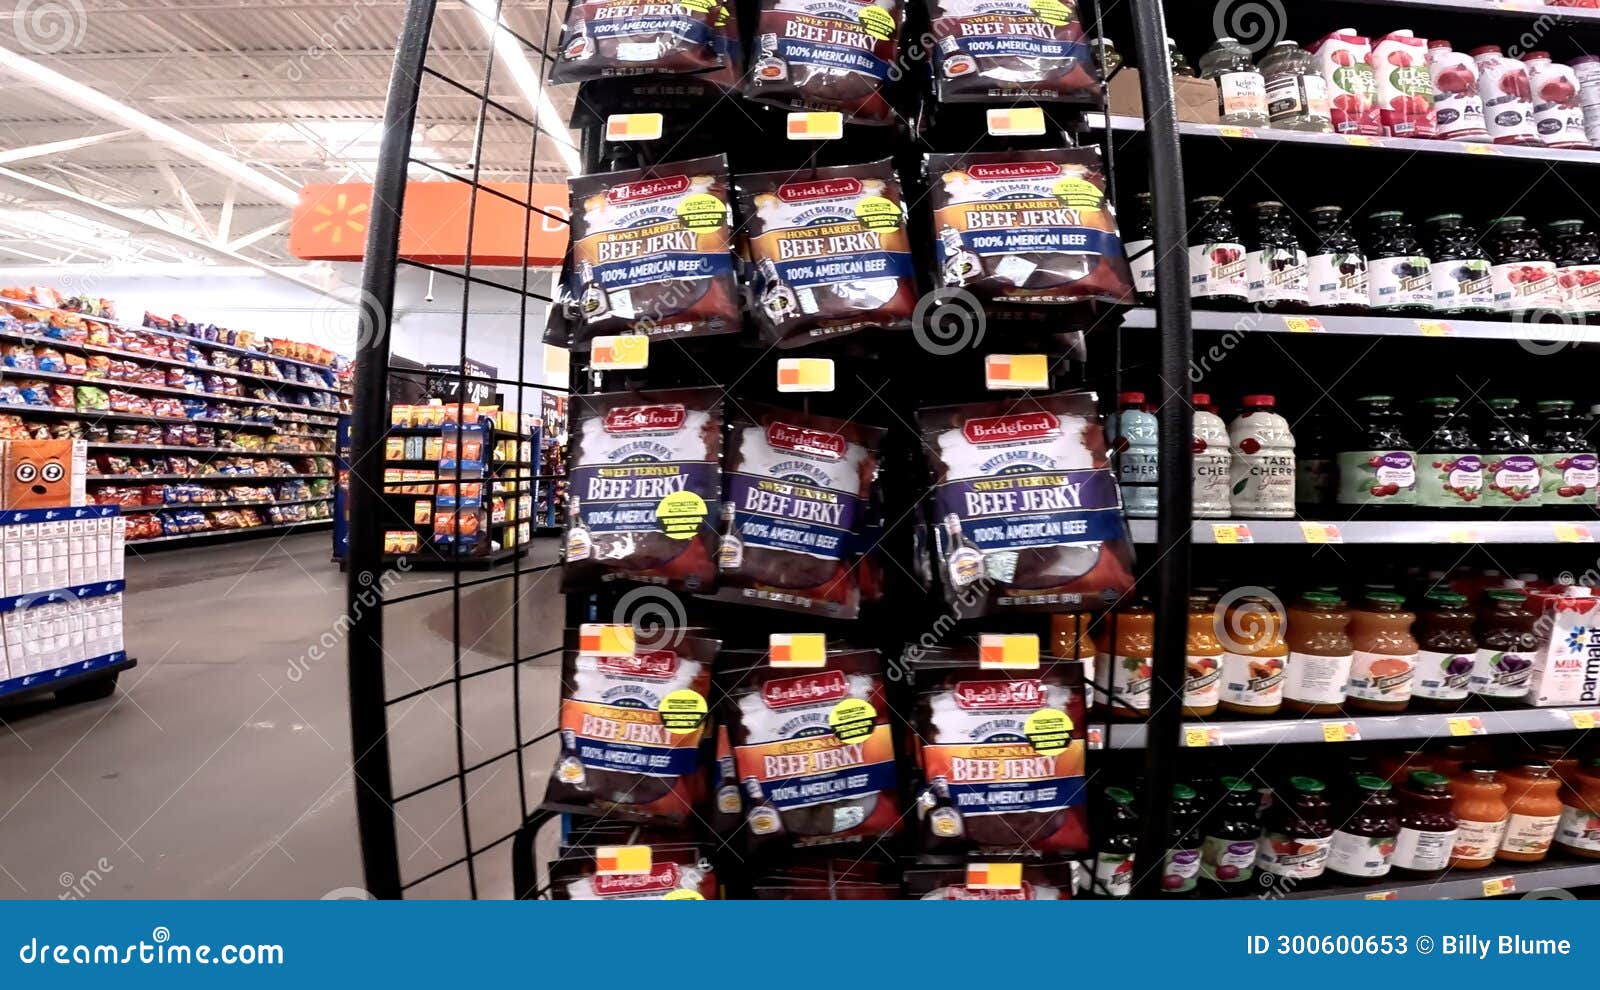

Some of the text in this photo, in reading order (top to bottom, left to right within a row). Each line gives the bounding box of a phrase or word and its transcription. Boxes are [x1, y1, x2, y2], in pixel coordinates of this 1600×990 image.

[594, 3, 693, 21] BEEF JERKY
[795, 15, 829, 27] SWEET
[967, 15, 1002, 24] SWEET
[594, 20, 693, 34] 100% AMERICAN BEEF
[785, 21, 879, 52] BEEF JERKY
[960, 22, 1057, 40] BEEF JERKY
[786, 45, 875, 69] 100% AMERICAN BEEF
[967, 41, 1063, 54] 100% AMERICAN BEEF
[787, 183, 854, 198] Bridgford
[975, 202, 1012, 212] HONEY
[966, 208, 1081, 229] BEEF JERKY
[786, 229, 819, 239] HONEY
[972, 234, 1087, 248] 100% AMERICAN BEEF
[598, 230, 698, 262] BEEF JERKY
[778, 230, 882, 260] BEEF JERKY
[600, 259, 700, 282] 100% AMERICAN BEEF
[786, 258, 887, 281] 100% AMERICAN BEEF
[972, 419, 1051, 438] Bridgford
[775, 429, 840, 452] Bridgford
[1122, 466, 1158, 475] CHER
[1250, 467, 1295, 477] CHERR
[587, 473, 690, 500] BEEF JERKY
[973, 479, 1013, 492] SWEET
[744, 486, 846, 526] BEEF JERKY
[965, 482, 1082, 517] BEEF JERKY
[614, 509, 656, 524] AMERICA
[742, 521, 840, 549] 100% AMERICAN BEEF
[973, 519, 1088, 543] 100% AMERICAN BEEF
[1579, 625, 1600, 702] parmalat
[581, 713, 673, 745] BEEF JERKY
[604, 748, 648, 766] AMERICAN
[648, 754, 672, 769] BEEF
[763, 742, 865, 779] BEEF JERKY
[951, 755, 1058, 781] BEEF JERKY
[800, 779, 847, 798] AMERICAN
[847, 773, 870, 789] BEEF
[987, 789, 1036, 805] AMERICAN
[1037, 787, 1058, 801] BEEF
